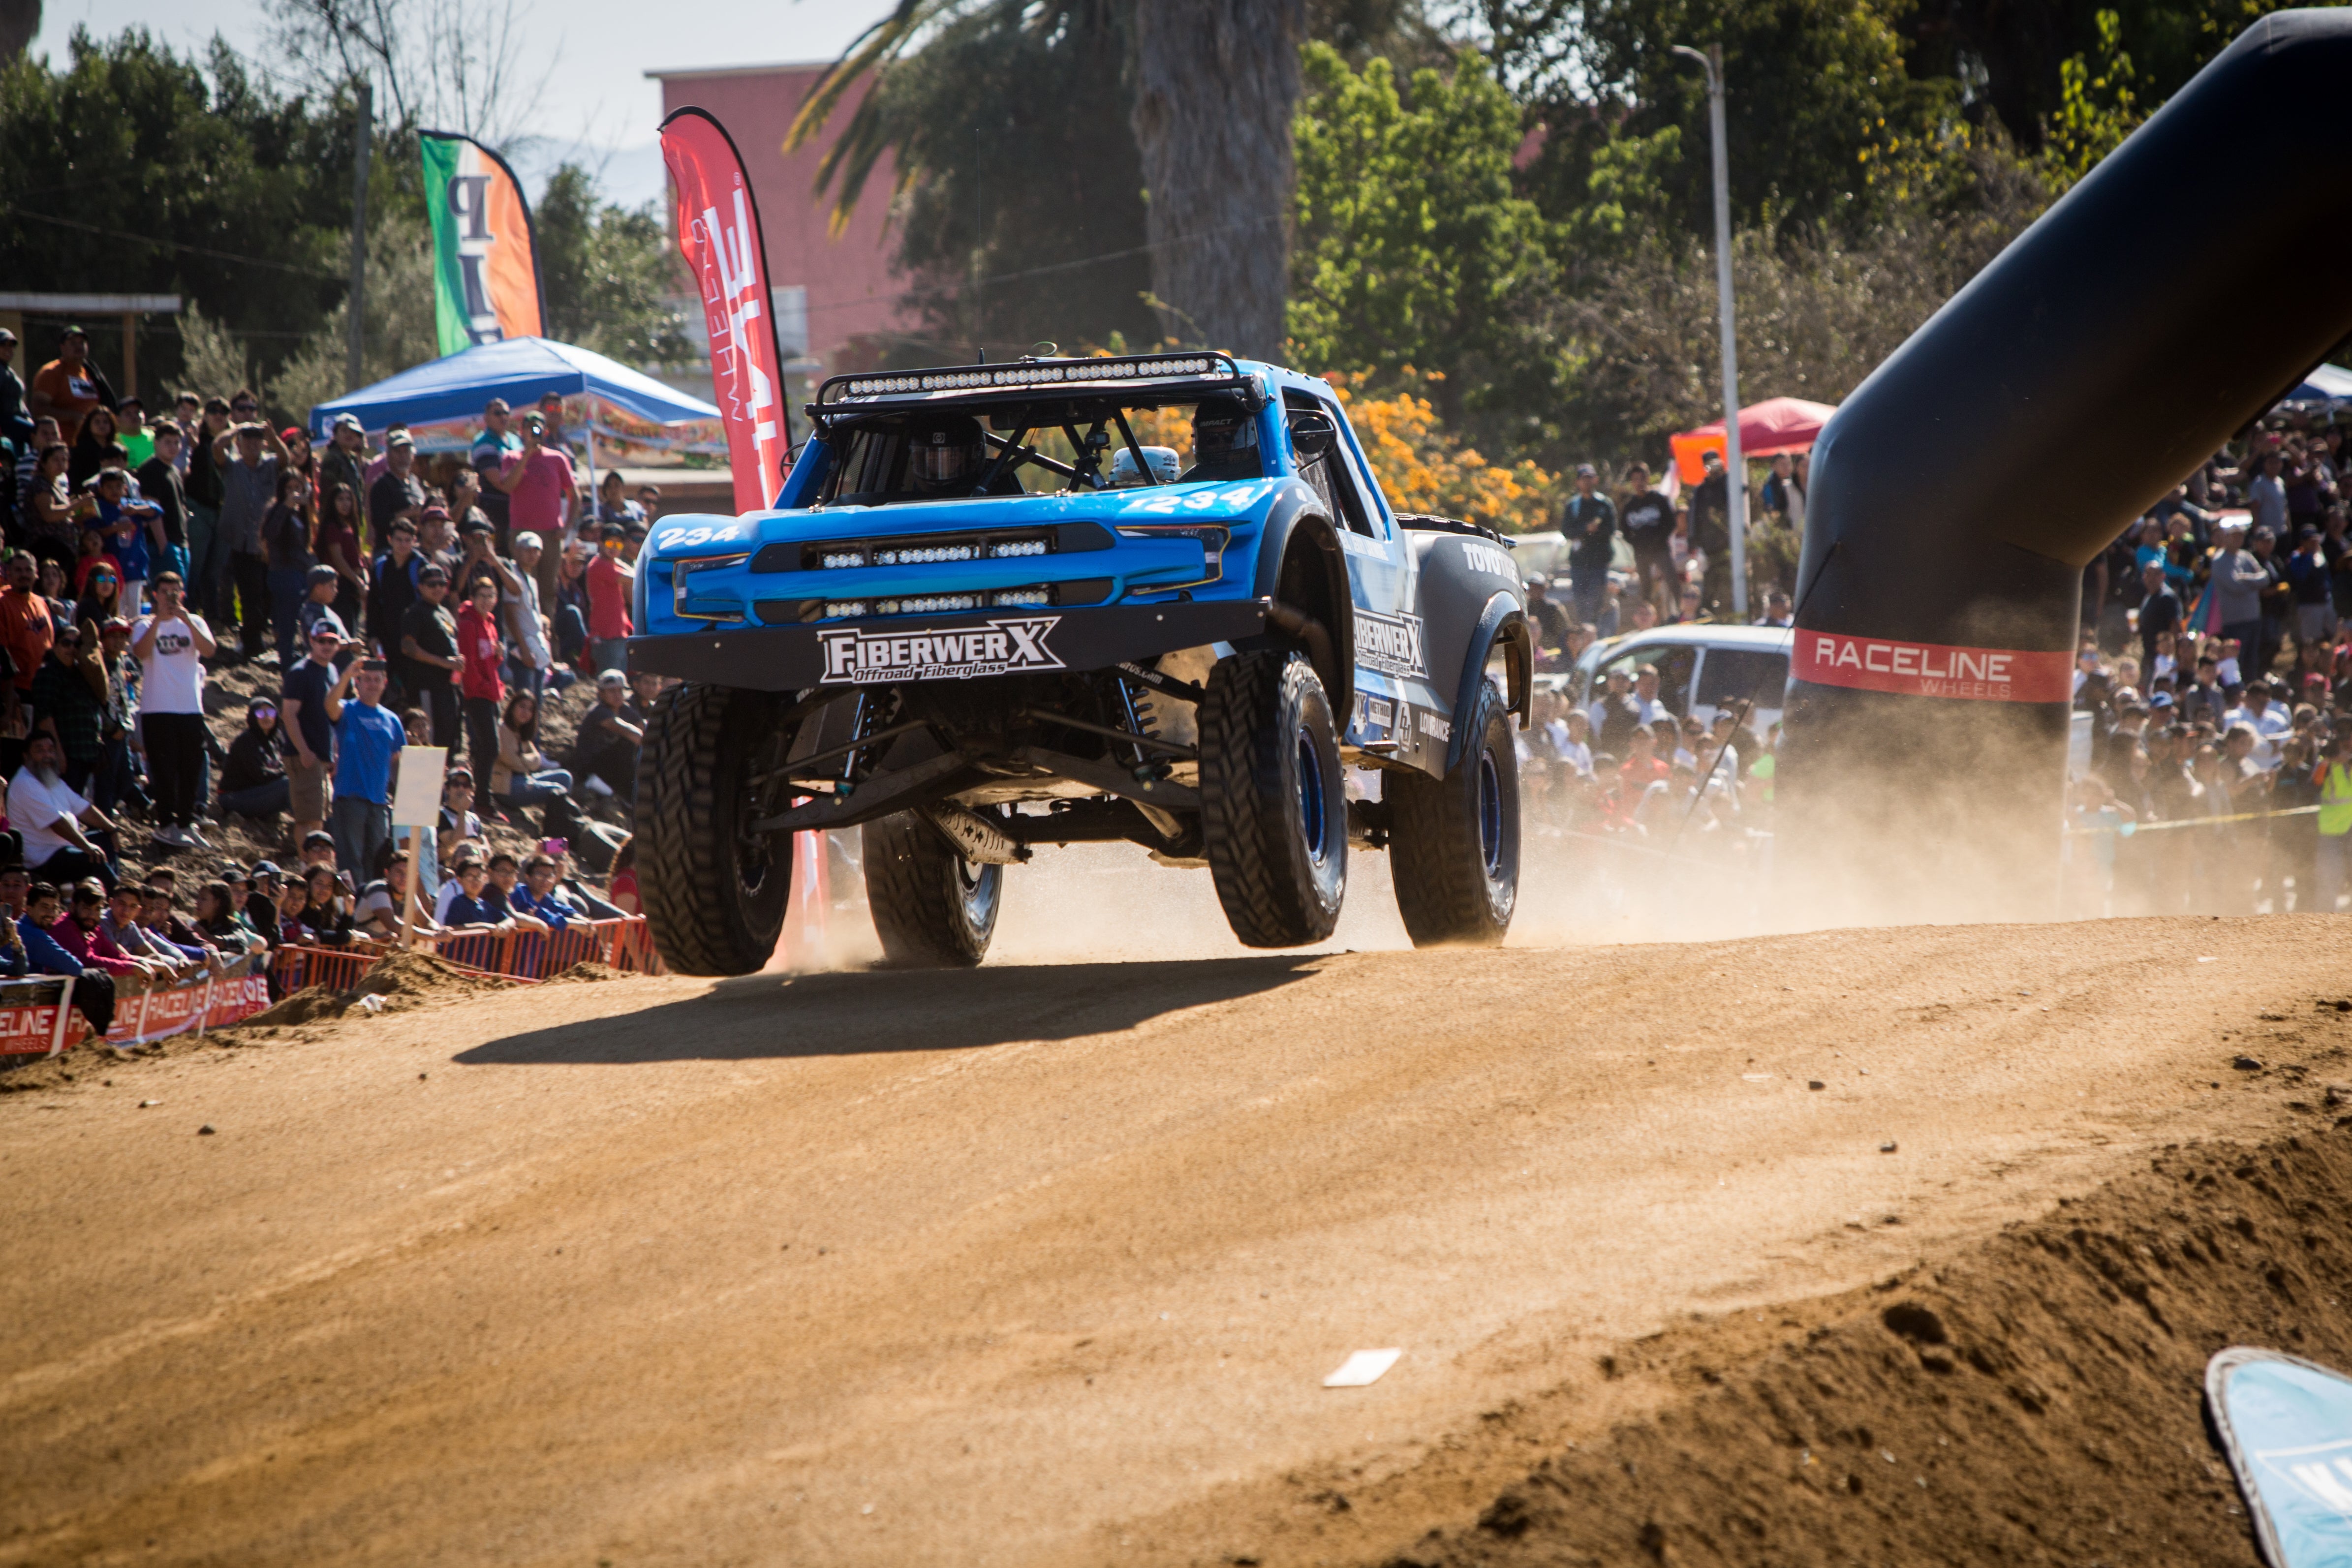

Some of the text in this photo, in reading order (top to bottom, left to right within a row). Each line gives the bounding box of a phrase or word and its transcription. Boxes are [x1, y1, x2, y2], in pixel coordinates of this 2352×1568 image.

[1199, 418, 1233, 427] IMPACT
[1145, 486, 1256, 514] 234
[657, 525, 740, 551] 234
[830, 625, 1044, 675] FIBERWERX
[1358, 649, 1410, 676] Offroad Fiberglass
[1815, 637, 2013, 682] RACELINE
[854, 662, 1005, 682] Offroad Fiberglass
[1920, 678, 2012, 699] WHEELS
[1370, 700, 1391, 718] METHOD
[1420, 711, 1450, 743] LOWRANCE
